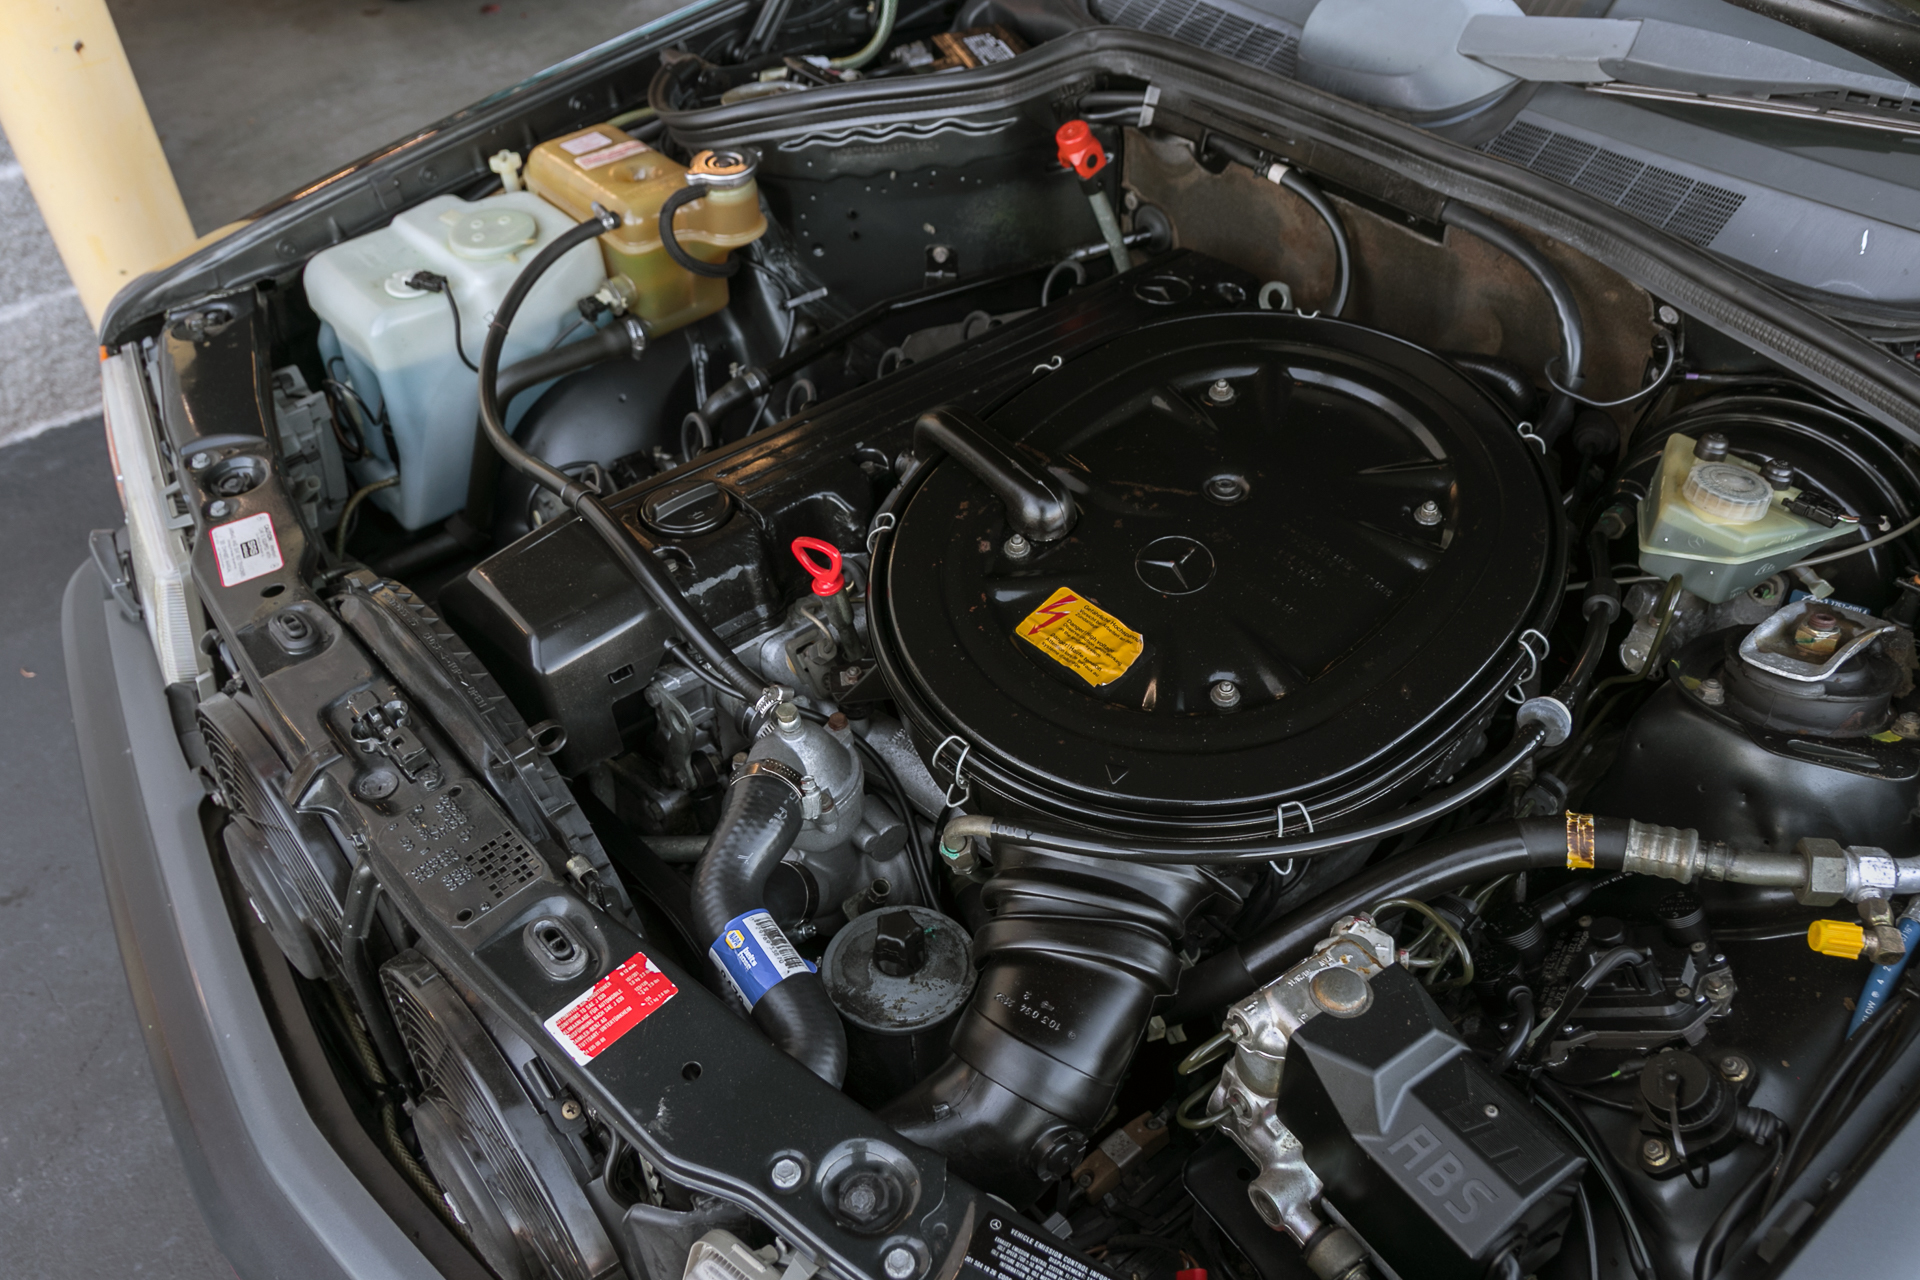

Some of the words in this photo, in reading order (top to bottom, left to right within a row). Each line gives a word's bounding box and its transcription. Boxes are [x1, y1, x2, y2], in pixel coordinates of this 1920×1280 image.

[728, 931, 742, 946] NAPA
[741, 946, 759, 967] belts
[596, 988, 623, 1009] AUTOMOBILE
[558, 1012, 581, 1030] CONFORMS
[584, 1001, 595, 1010] SAE
[591, 1009, 605, 1021] NACH
[1019, 1002, 1039, 1019] 094
[577, 1029, 601, 1048] TUTTGART-
[598, 1004, 632, 1032] UNTERTÜRKHEIM
[1040, 1014, 1061, 1031] 103
[1386, 1123, 1499, 1224] ABS
[1010, 1228, 1034, 1245] VEHICLE
[1034, 1241, 1063, 1260] EMISSION
[1063, 1256, 1089, 1274] CONTROL
[1012, 1245, 1030, 1258] EMISSION
[1030, 1254, 1048, 1268] CONTROL
[999, 1261, 1026, 1278] INFORMATION
